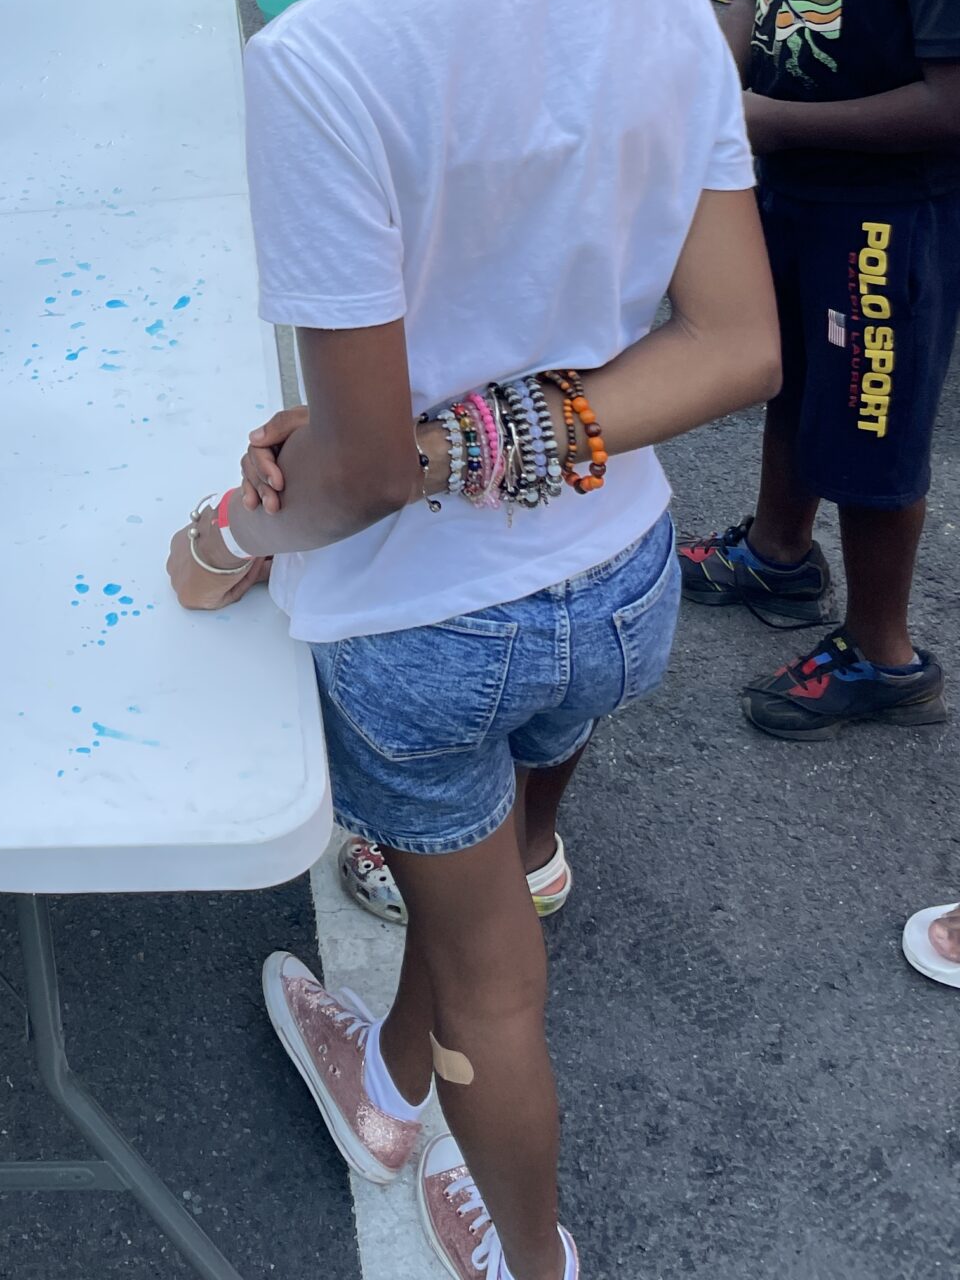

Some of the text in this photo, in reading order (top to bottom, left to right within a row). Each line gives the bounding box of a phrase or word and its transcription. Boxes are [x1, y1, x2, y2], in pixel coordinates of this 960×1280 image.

[848, 332, 860, 408] LAUREN
[857, 222, 895, 438] POLO SPORT
